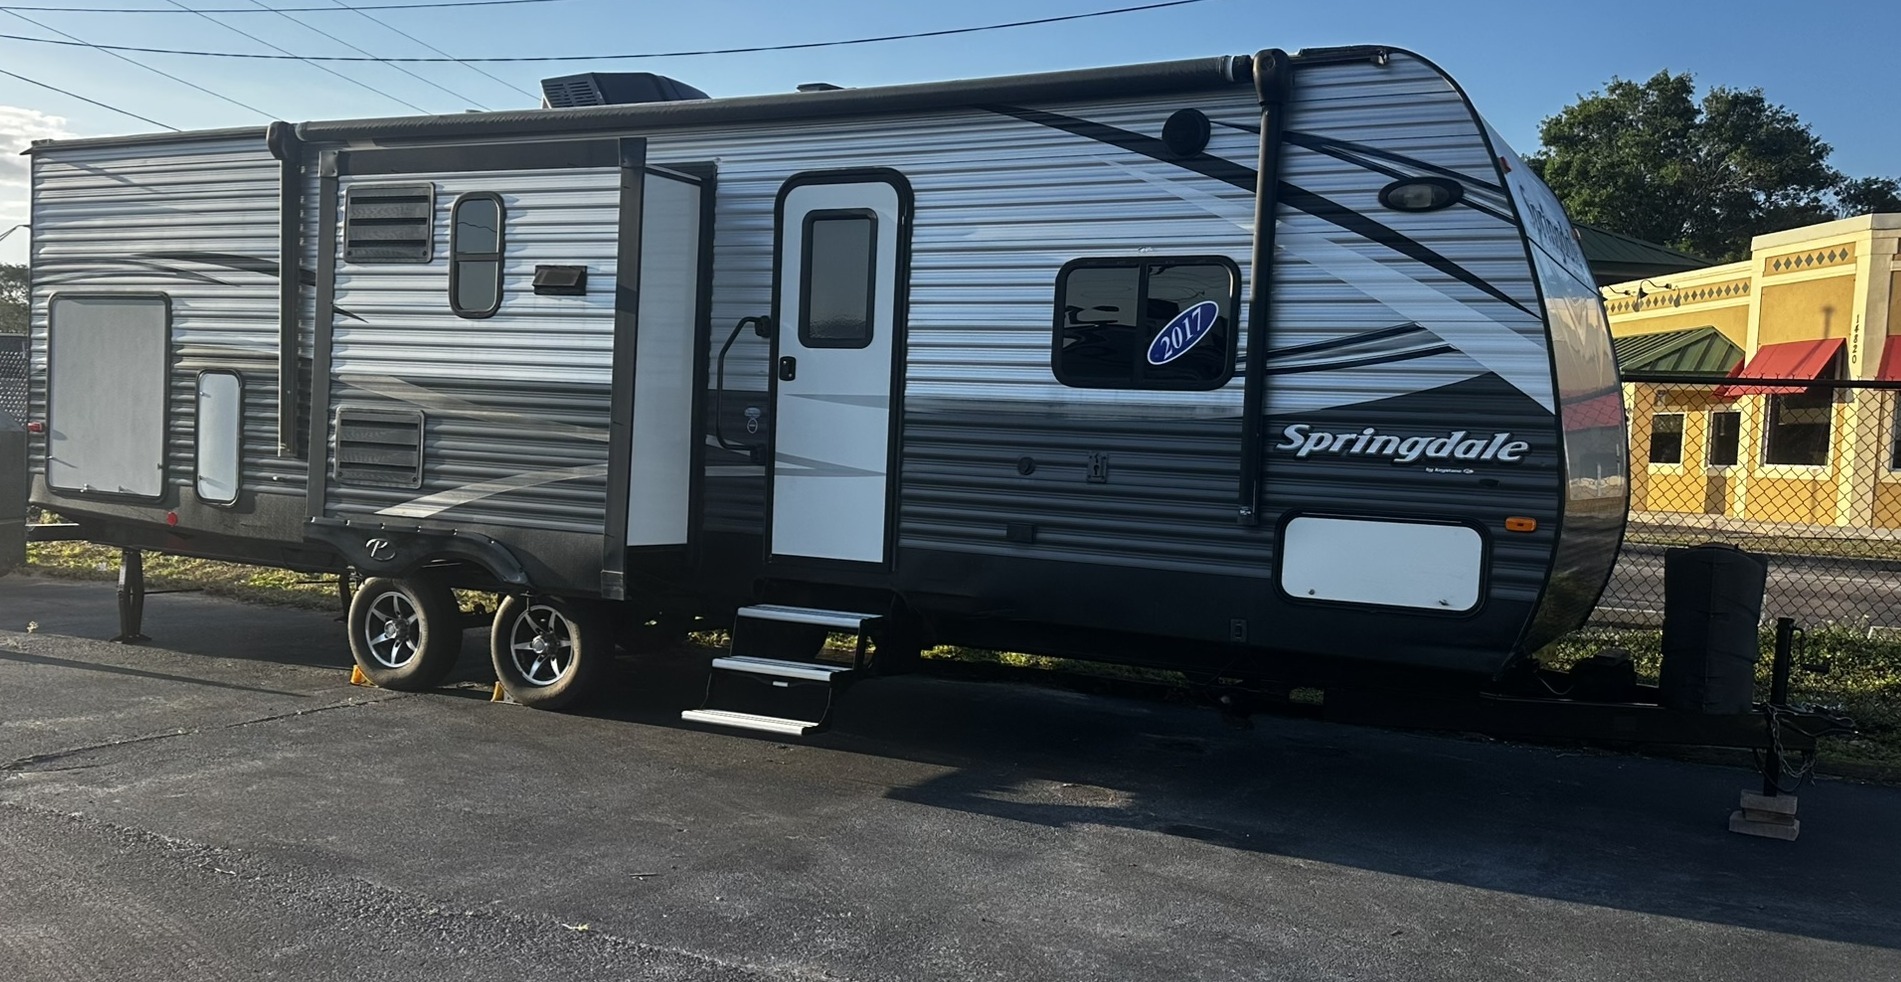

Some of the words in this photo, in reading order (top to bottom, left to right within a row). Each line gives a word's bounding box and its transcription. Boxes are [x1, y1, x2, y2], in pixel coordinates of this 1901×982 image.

[1160, 306, 1203, 360] 2017
[1851, 313, 1860, 364] 14820
[1275, 423, 1531, 464] Springdale
